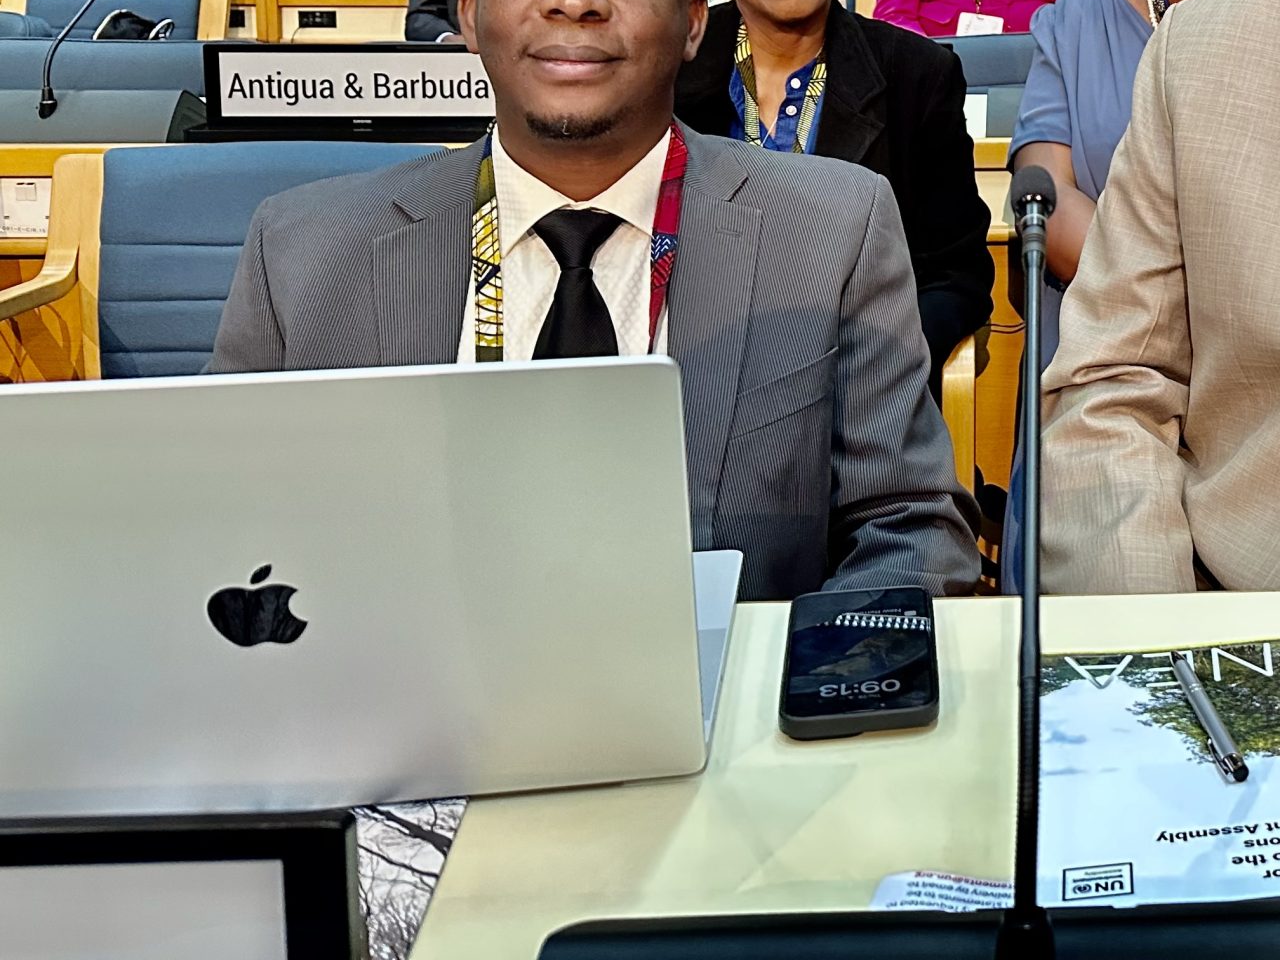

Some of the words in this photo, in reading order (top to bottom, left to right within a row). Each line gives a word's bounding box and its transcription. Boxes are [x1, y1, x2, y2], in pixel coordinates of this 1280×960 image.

[227, 71, 335, 106] Antigua
[343, 72, 364, 99] &
[373, 71, 490, 99] Barbuda
[818, 679, 901, 698] 09:13
[1156, 823, 1260, 843] Assembly
[1231, 853, 1267, 866] the
[1094, 879, 1124, 893] UN
